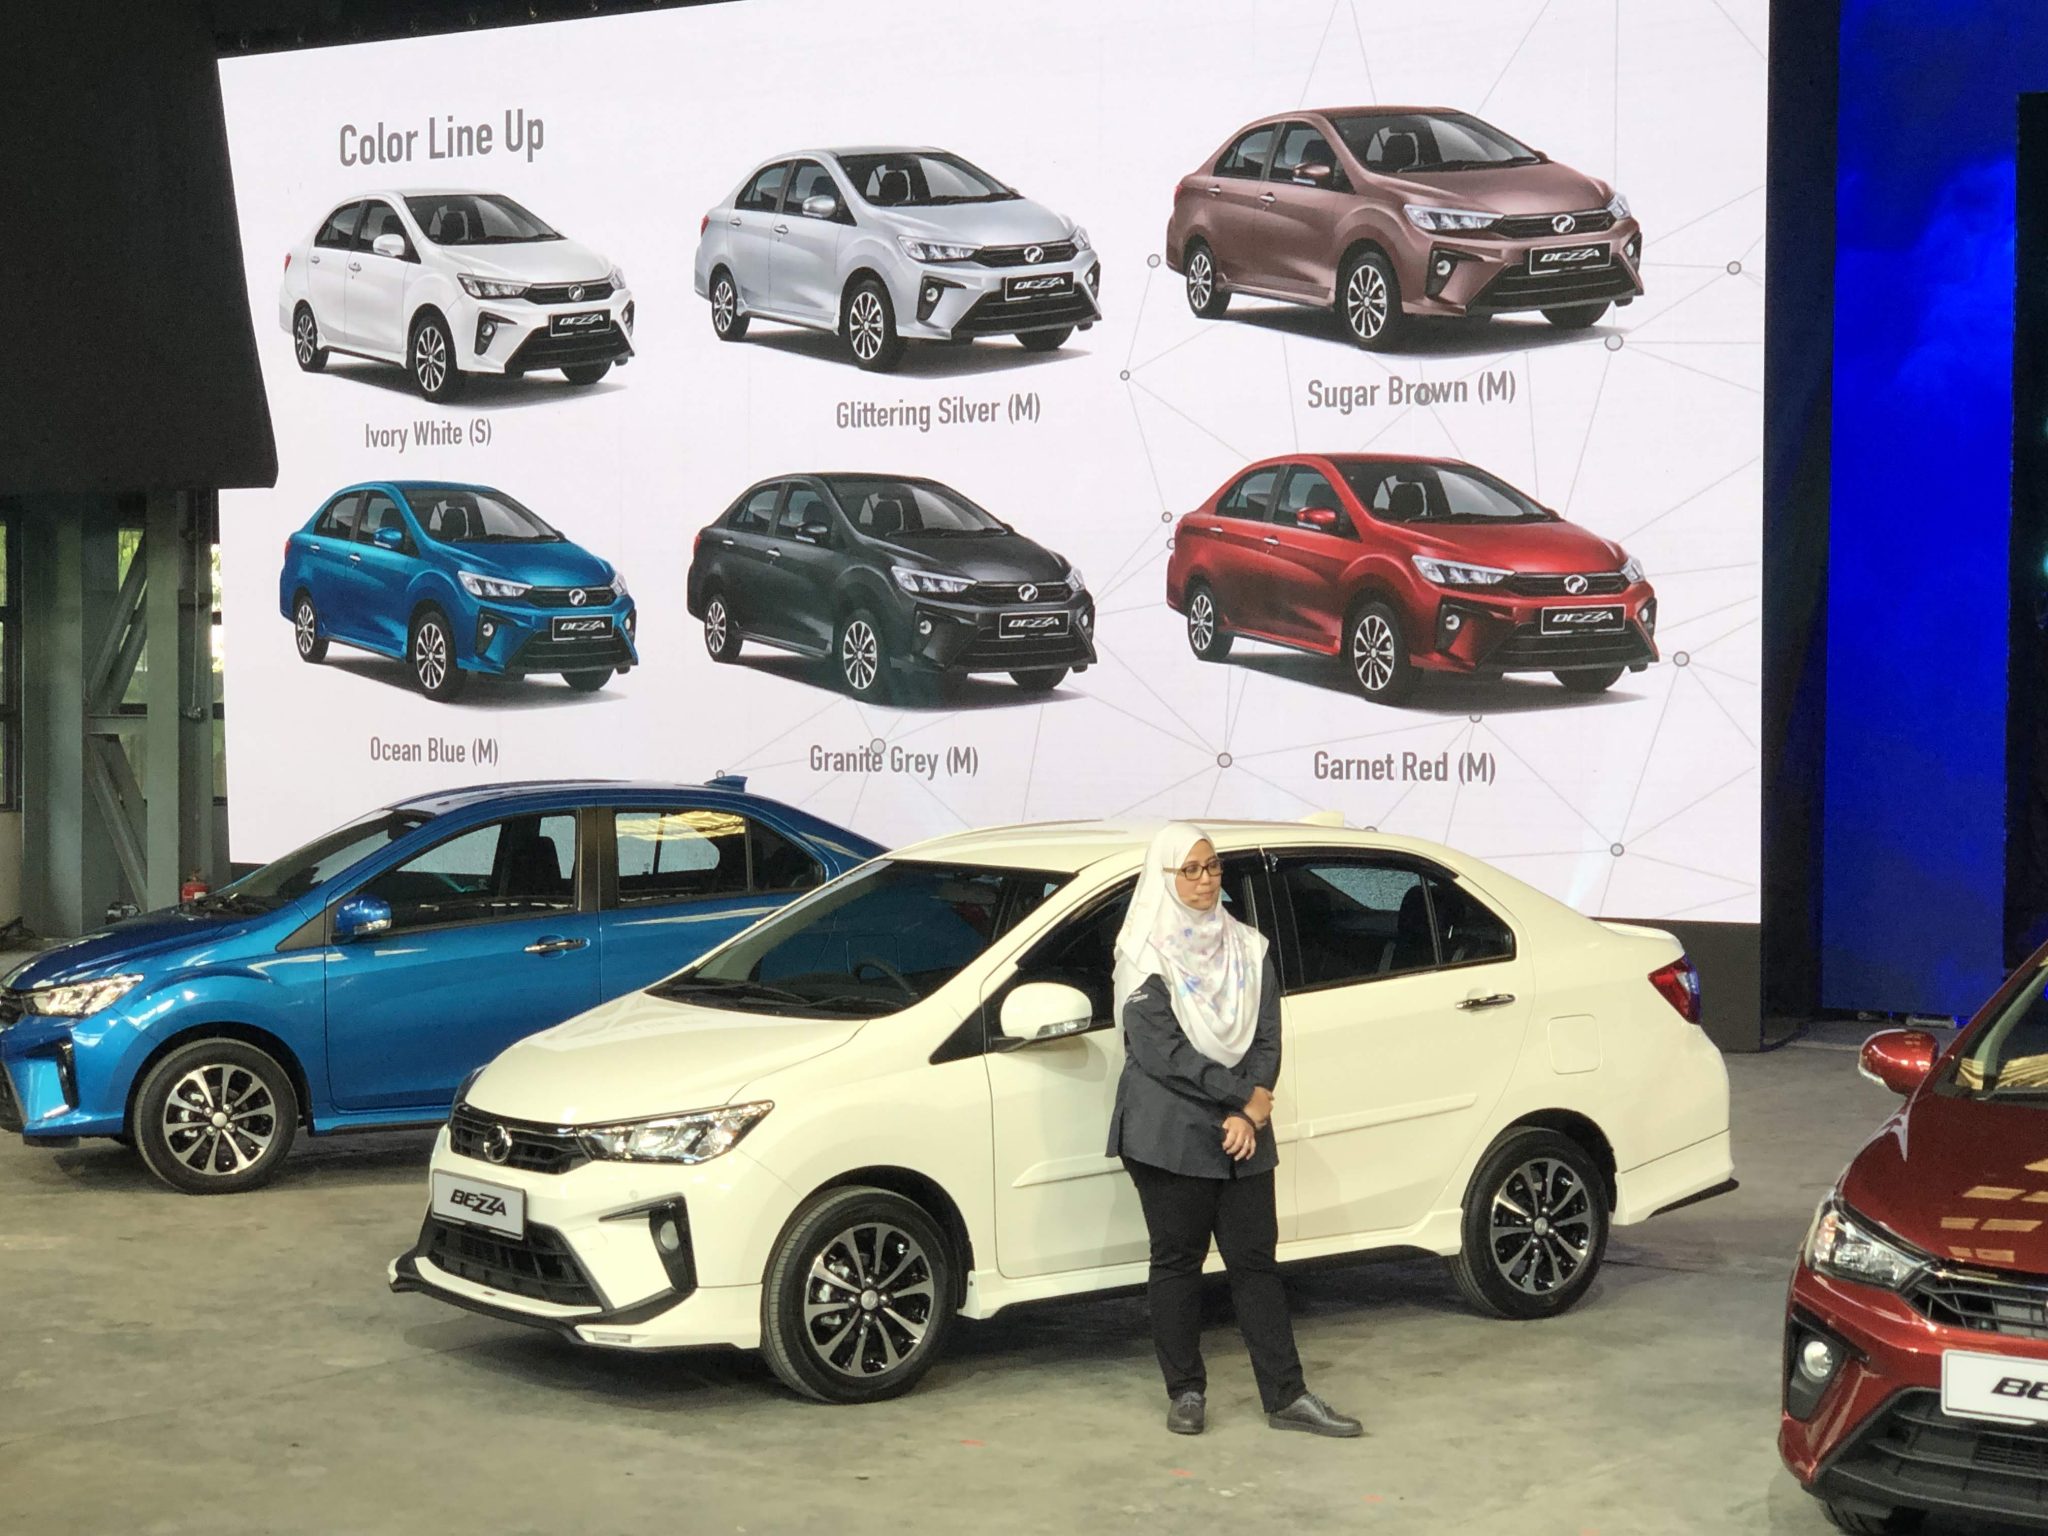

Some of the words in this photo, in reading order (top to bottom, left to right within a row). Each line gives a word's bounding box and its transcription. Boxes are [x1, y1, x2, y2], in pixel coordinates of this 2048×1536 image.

[339, 121, 419, 167] Color
[429, 115, 493, 160] Line
[505, 108, 545, 163] Up
[1307, 379, 1381, 416] Sugar
[1388, 375, 1468, 406] Brown
[1478, 370, 1516, 404] (M)
[836, 401, 931, 433] Glittering
[938, 396, 1001, 424] Silver
[1007, 393, 1041, 425] (M)
[365, 423, 409, 454] Ivory
[413, 419, 463, 446] White
[469, 418, 492, 446] (S)
[370, 736, 422, 762] Ocean
[428, 737, 466, 763] Blue
[472, 738, 499, 767] (M)
[810, 744, 886, 773] Granite
[890, 745, 939, 781] Grey
[946, 746, 979, 777] (M)
[1314, 750, 1395, 781] Garnet
[1402, 751, 1448, 782] Red
[1458, 752, 1496, 786] (M)
[450, 1189, 507, 1216] BEZZA
